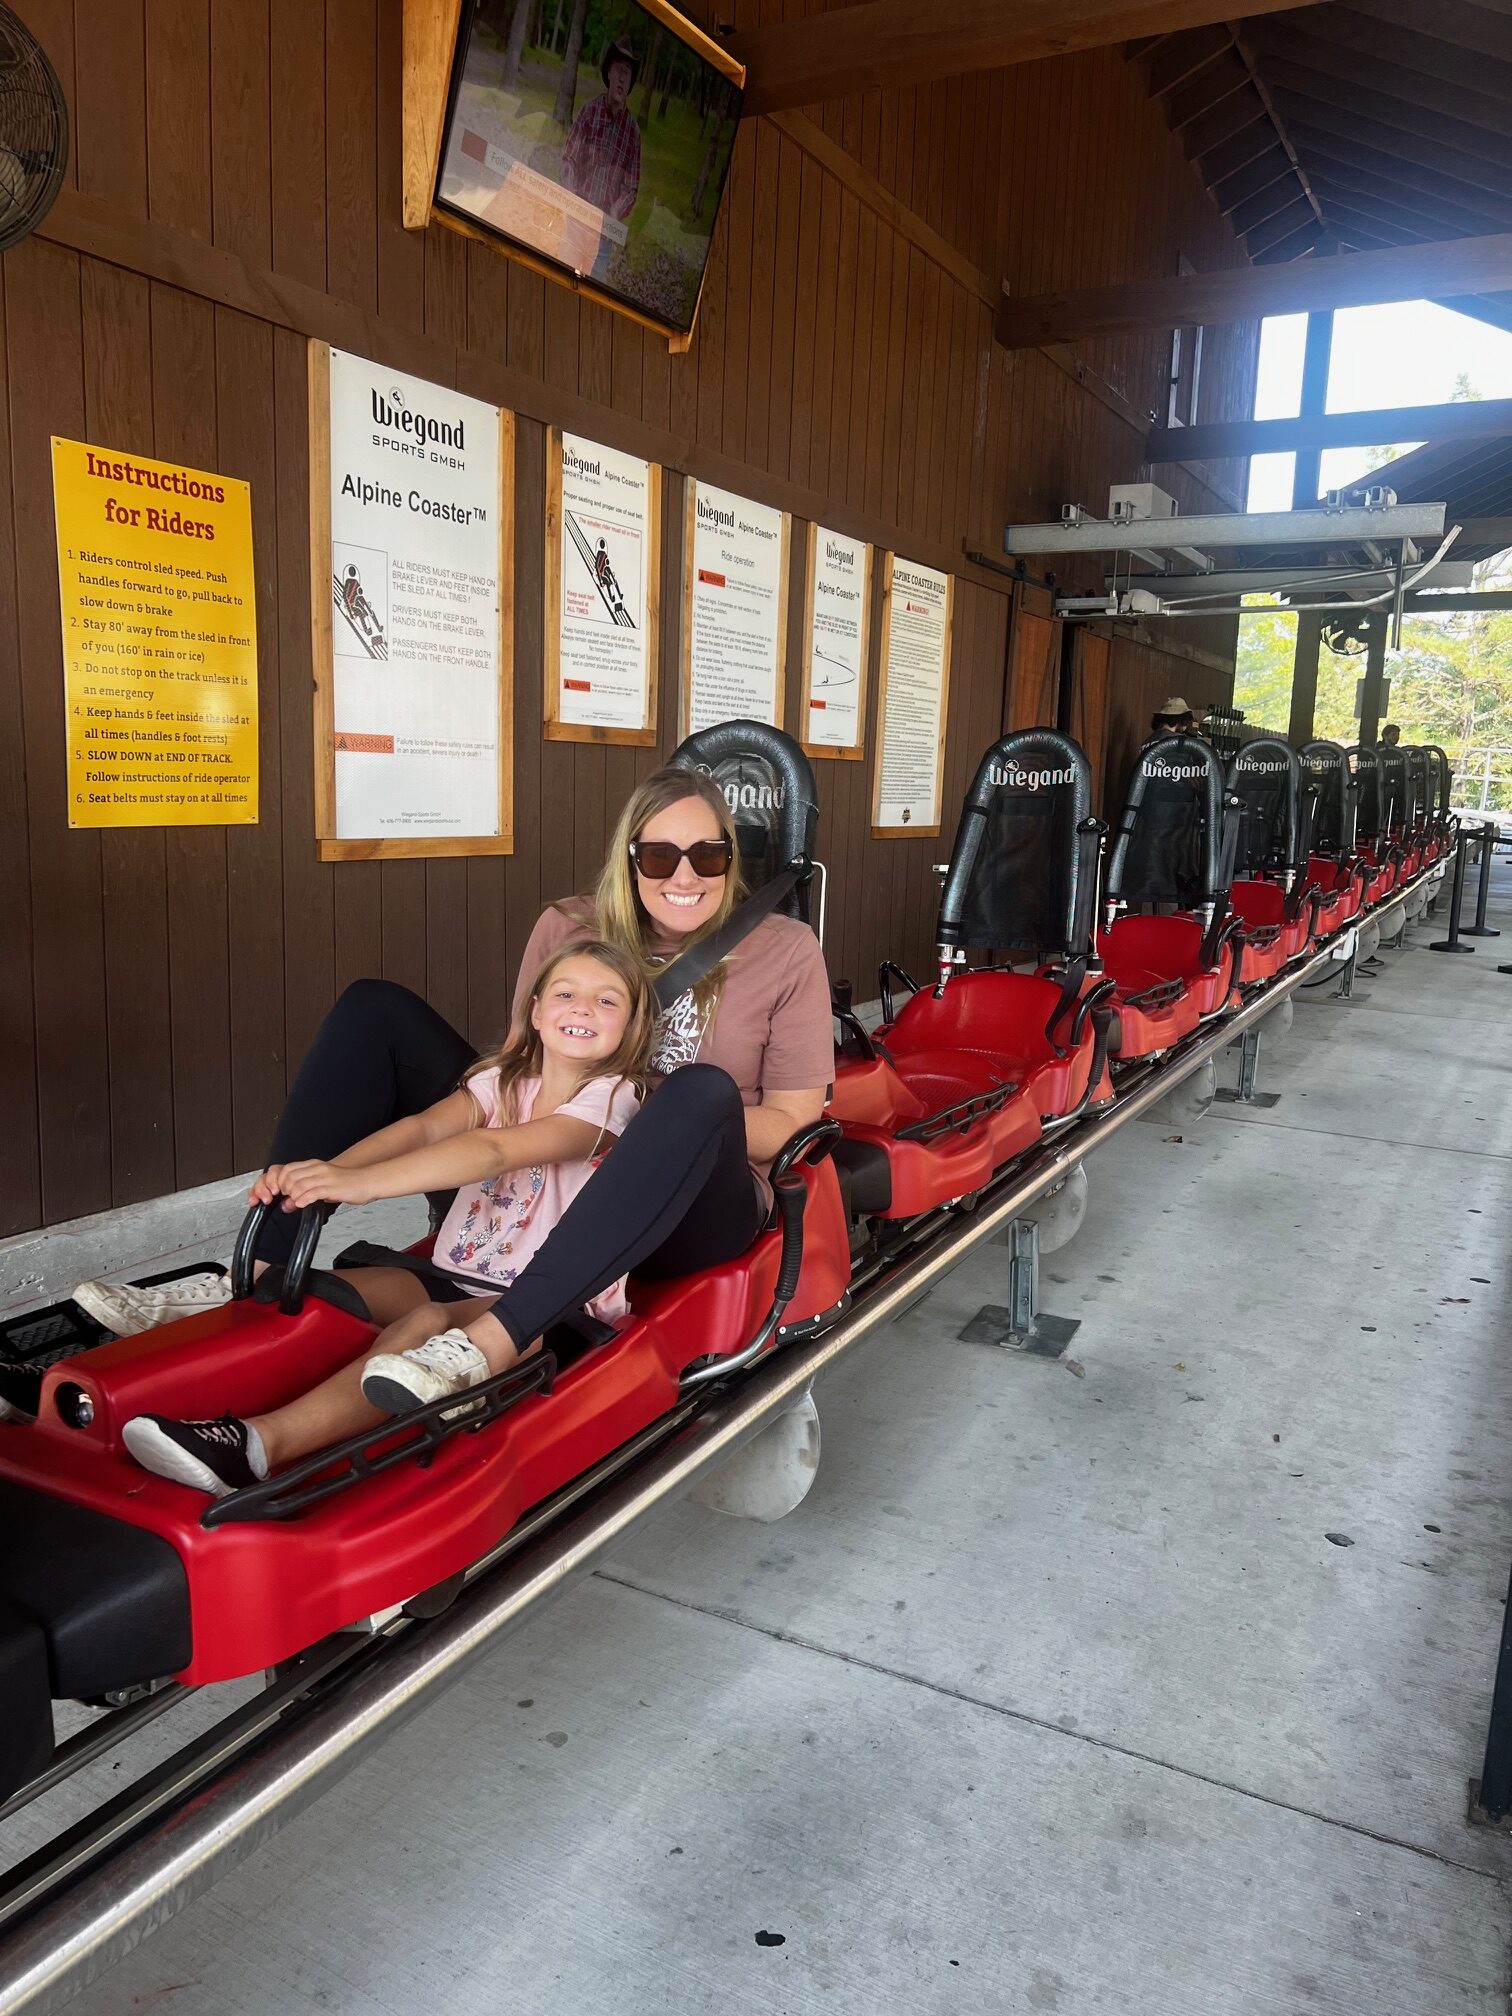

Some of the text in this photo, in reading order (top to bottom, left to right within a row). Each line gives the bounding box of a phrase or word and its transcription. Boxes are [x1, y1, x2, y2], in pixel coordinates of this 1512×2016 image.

[371, 388, 464, 450] Wiegand
[372, 435, 465, 471] SPORTS GMBH
[605, 471, 620, 483] Alpine
[86, 452, 225, 540] Instructions for Riders
[341, 474, 402, 508] Alpine
[698, 498, 734, 527] Wiegand
[739, 521, 754, 534] Alpine
[721, 550, 755, 568] Ride operation
[827, 542, 854, 565] Wiegand
[68, 550, 227, 583] 1. Riders control sled speed. Push
[393, 560, 495, 588] ALL RIDERS MUST KEEP HAND ON
[79, 572, 243, 606] handles forward to go, pull back to
[392, 570, 489, 597] BRAKE LEVER AND FEET INSIDE
[393, 582, 467, 602] THE SLED AT ALL TIMES
[818, 581, 835, 595] Alpine
[80, 596, 173, 617] slow down & brake
[392, 604, 477, 625] DRIVERS MUST KEEP BOTH
[71, 617, 79, 627] 2.
[83, 618, 105, 632] Stay
[127, 625, 152, 637] away
[155, 626, 178, 639] from
[181, 630, 195, 640] the
[198, 633, 215, 643] sled
[218, 634, 226, 644] in
[229, 635, 250, 647] front
[392, 616, 416, 626] HANDS
[417, 620, 427, 628] ON
[430, 621, 441, 630] THE
[443, 624, 463, 634] BRAKE
[82, 640, 93, 650] of
[95, 643, 114, 654] you
[143, 646, 152, 656] in
[155, 648, 174, 659] rain
[177, 651, 186, 660] or
[189, 651, 204, 663] ice)
[392, 638, 491, 658] PASSENGERS MUST KEEP BOTH
[392, 649, 416, 659] HANDS
[430, 654, 441, 662] THE
[443, 656, 464, 665] FRONT
[73, 662, 247, 685] 3. Do not stop on the track unless it is
[84, 686, 154, 701] an emergency
[74, 707, 82, 716] 4.
[87, 707, 112, 720] Keep
[115, 708, 144, 719] hands
[147, 711, 152, 719] &
[156, 711, 174, 720] feet
[177, 711, 203, 722] inside
[222, 715, 238, 724] sled
[241, 716, 249, 724] at
[85, 728, 227, 745] all times (handles & foot rests)
[76, 751, 233, 763] 5. SLOW DOWN at END OF TRACK.
[1236, 756, 1290, 775] Wiegand
[1357, 758, 1379, 769] gand
[86, 772, 250, 785] Follow instructions of ride operator
[989, 761, 1076, 792] Wiegand
[1142, 760, 1210, 781] Wiegand
[77, 792, 247, 805] 6. Seat belts must stay on at all times
[724, 776, 785, 815] gand
